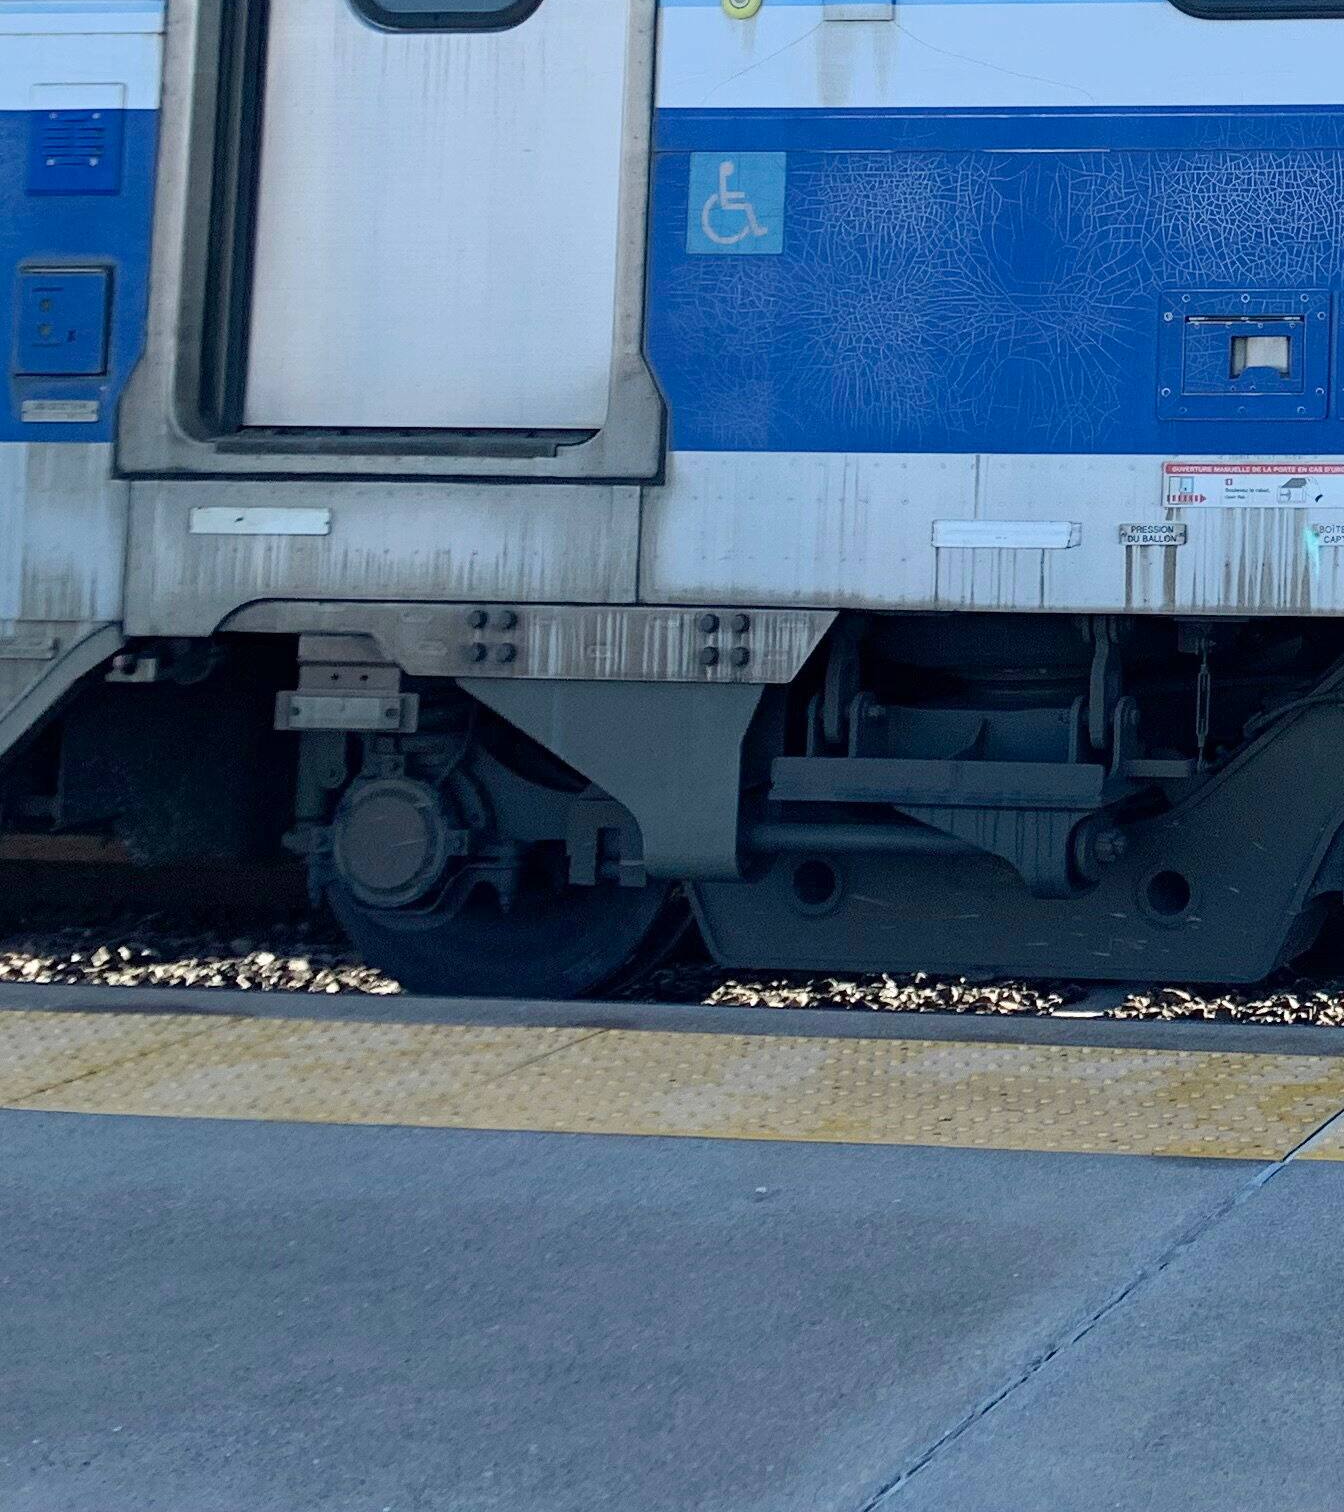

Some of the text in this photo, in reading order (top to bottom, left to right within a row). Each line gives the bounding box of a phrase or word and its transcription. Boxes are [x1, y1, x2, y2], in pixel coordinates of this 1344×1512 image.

[1131, 525, 1174, 534] PRESSION
[1127, 535, 1177, 543] DU BALLON
